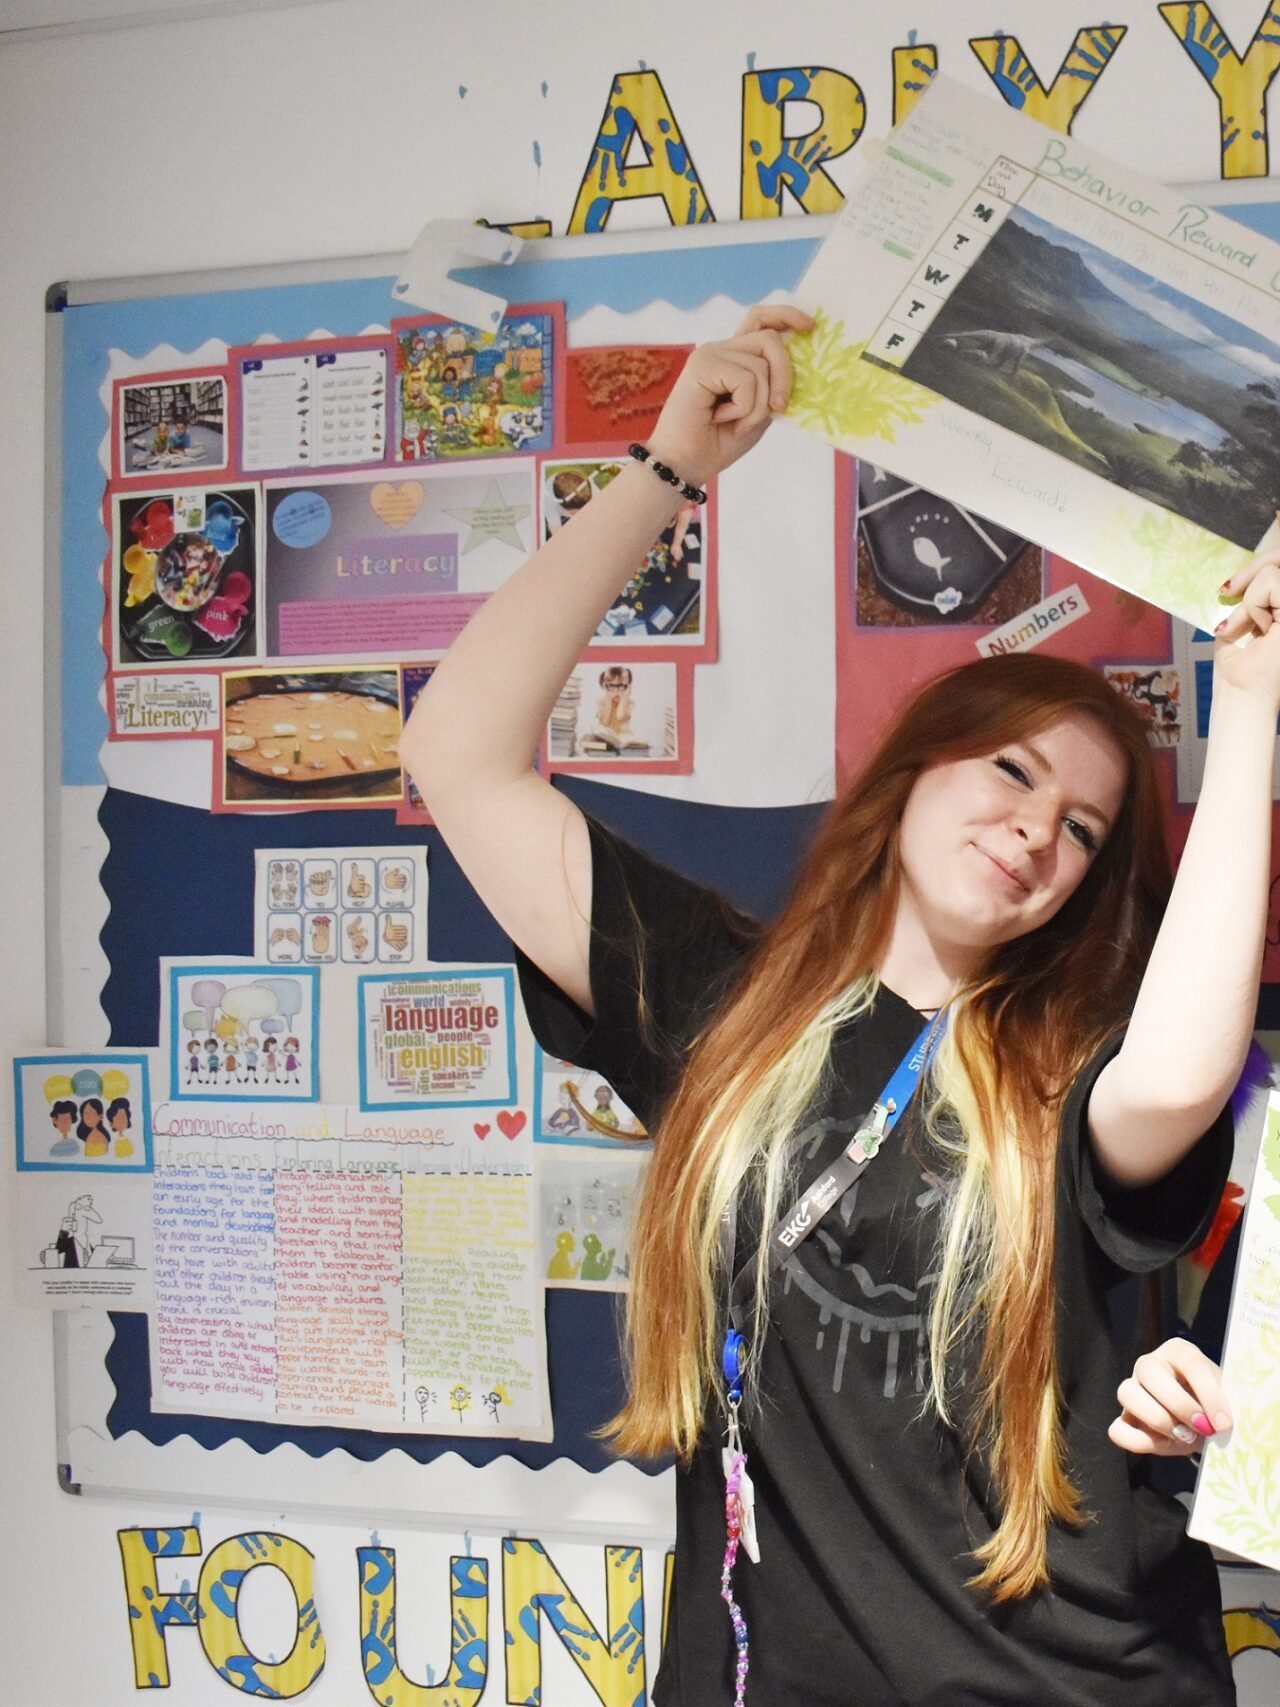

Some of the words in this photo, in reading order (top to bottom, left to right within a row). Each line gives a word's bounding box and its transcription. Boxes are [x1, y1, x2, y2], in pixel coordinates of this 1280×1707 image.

[987, 175, 1007, 199] Day
[973, 202, 995, 223] M
[1036, 138, 1160, 218] Behavior
[1168, 204, 1258, 268] Reward
[953, 233, 970, 251] T
[925, 264, 949, 286] W
[908, 299, 926, 319] T
[886, 332, 905, 352] F
[336, 553, 456, 579] Literacy
[148, 614, 175, 633] green
[206, 610, 231, 623] pink
[988, 593, 1080, 656] Numbers
[127, 702, 203, 731] Literacy
[391, 981, 482, 996] communications
[413, 994, 445, 1009] world
[385, 1004, 499, 1034] language
[385, 1031, 426, 1050] global
[437, 1031, 473, 1044] people
[400, 1042, 483, 1071] english
[432, 1069, 470, 1081] speakers
[153, 1103, 287, 1138] Communication
[295, 1108, 334, 1138] and
[344, 1108, 445, 1150] Language
[777, 1211, 813, 1248] EKC
